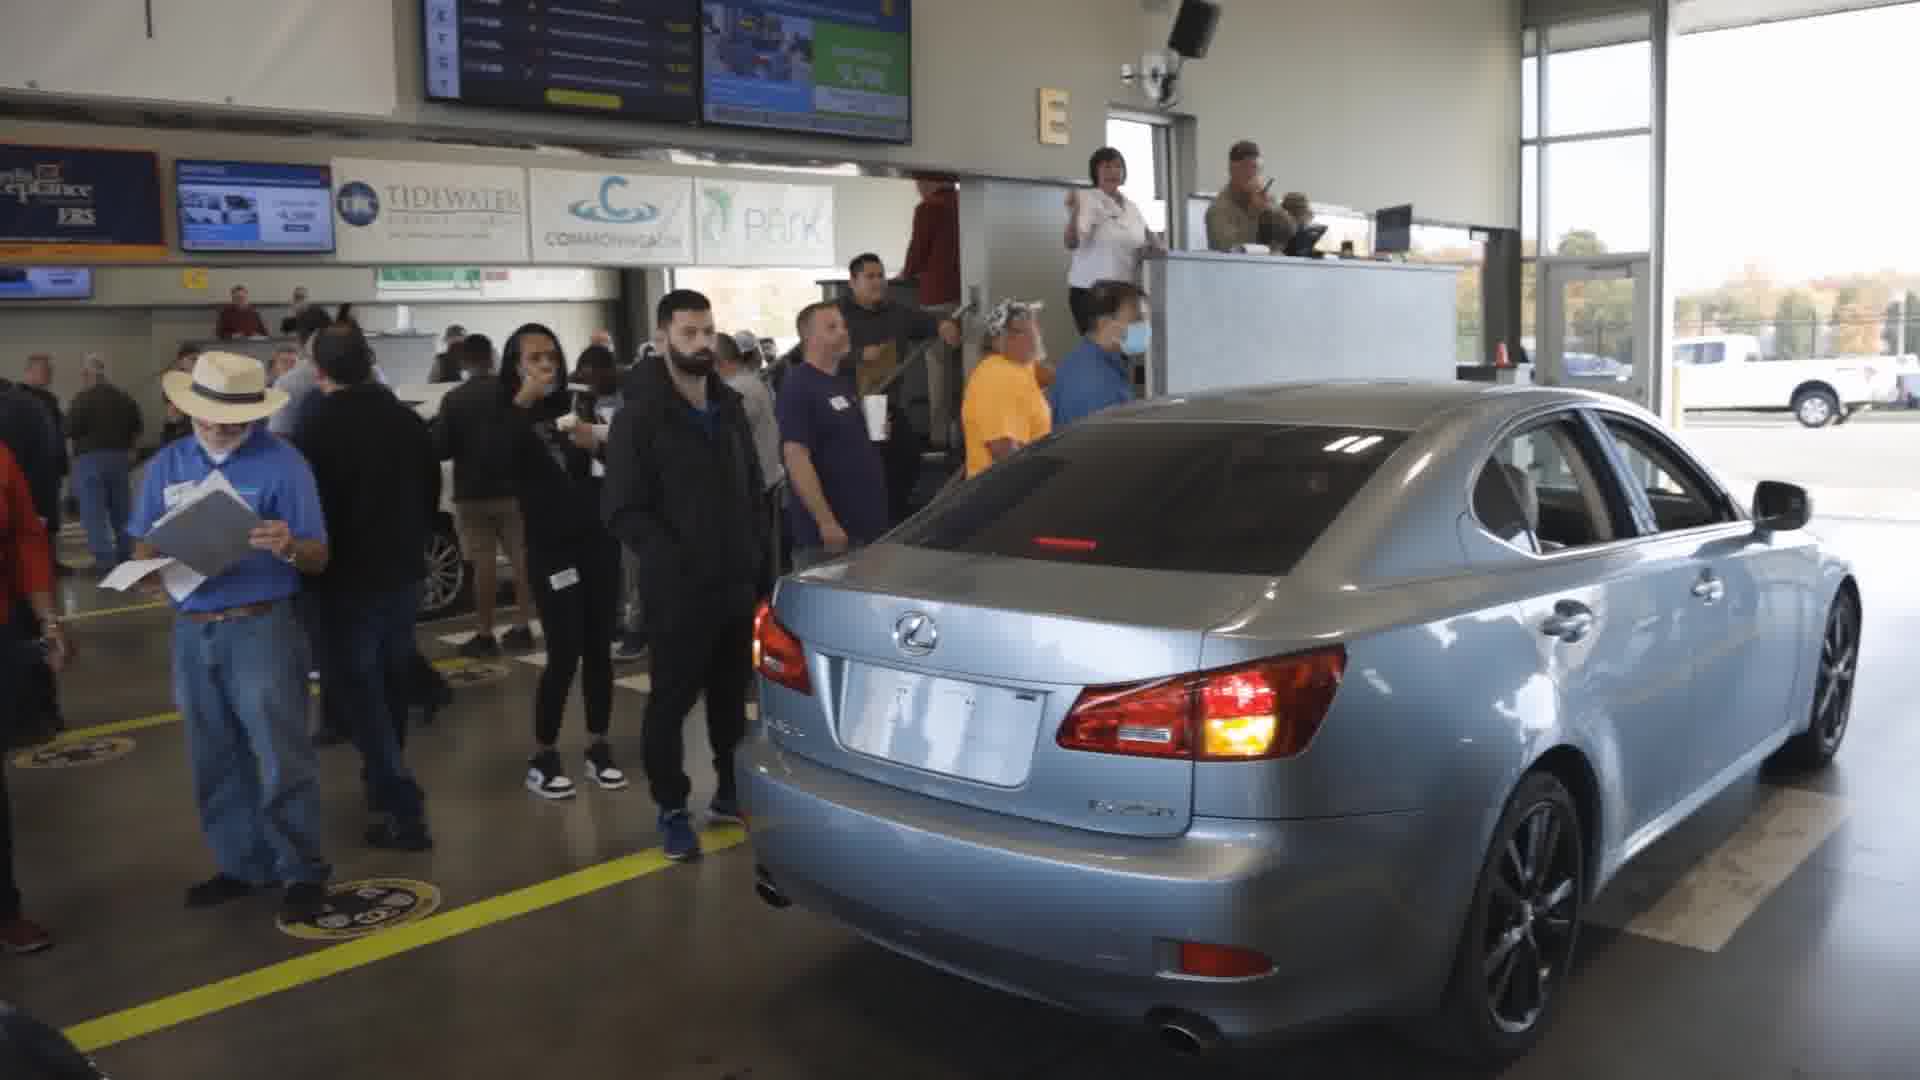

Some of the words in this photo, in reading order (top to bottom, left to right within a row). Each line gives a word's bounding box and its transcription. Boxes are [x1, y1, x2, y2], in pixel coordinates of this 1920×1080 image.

[1039, 88, 1071, 145] E
[385, 184, 521, 210] TIDEWATER
[544, 231, 682, 248] COMMONAL
